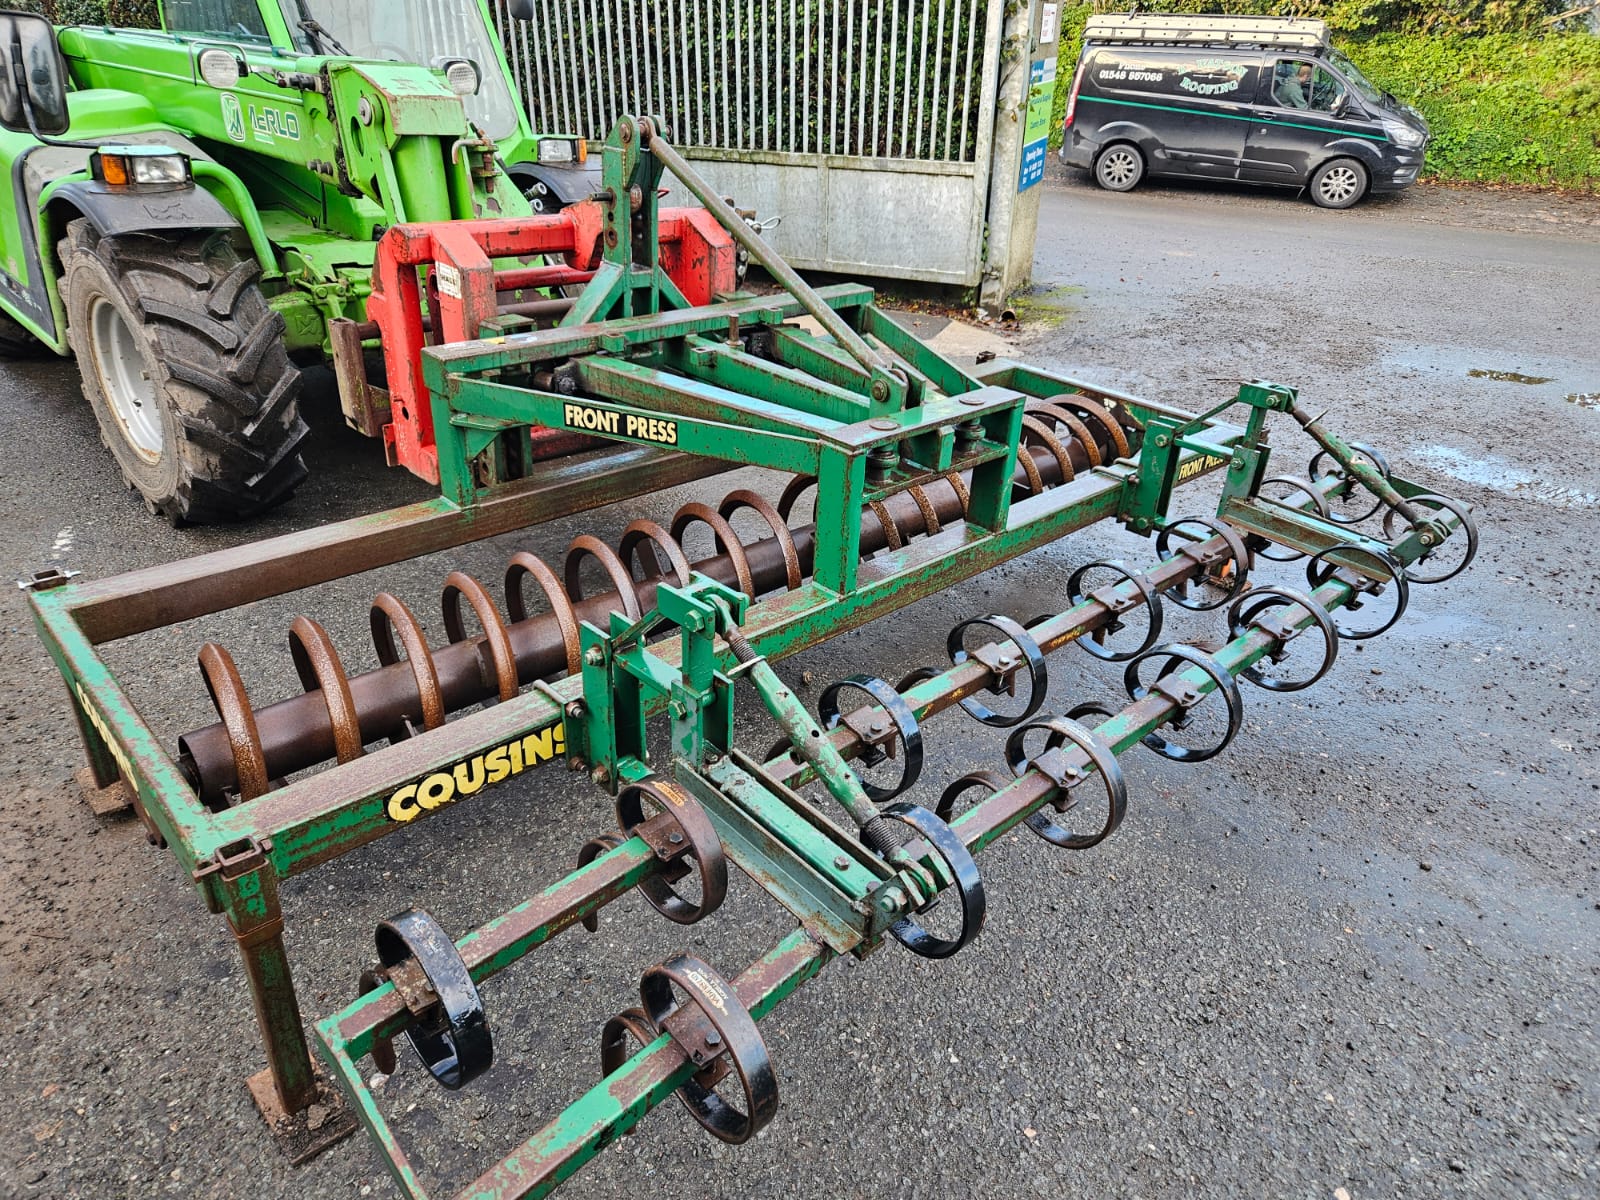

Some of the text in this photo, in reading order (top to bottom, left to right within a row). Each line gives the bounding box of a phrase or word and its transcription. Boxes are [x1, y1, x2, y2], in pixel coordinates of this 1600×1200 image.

[1180, 77, 1239, 95] ROOFING
[564, 404, 677, 444] FRONT PRESS
[1179, 454, 1224, 480] FRONT PRE
